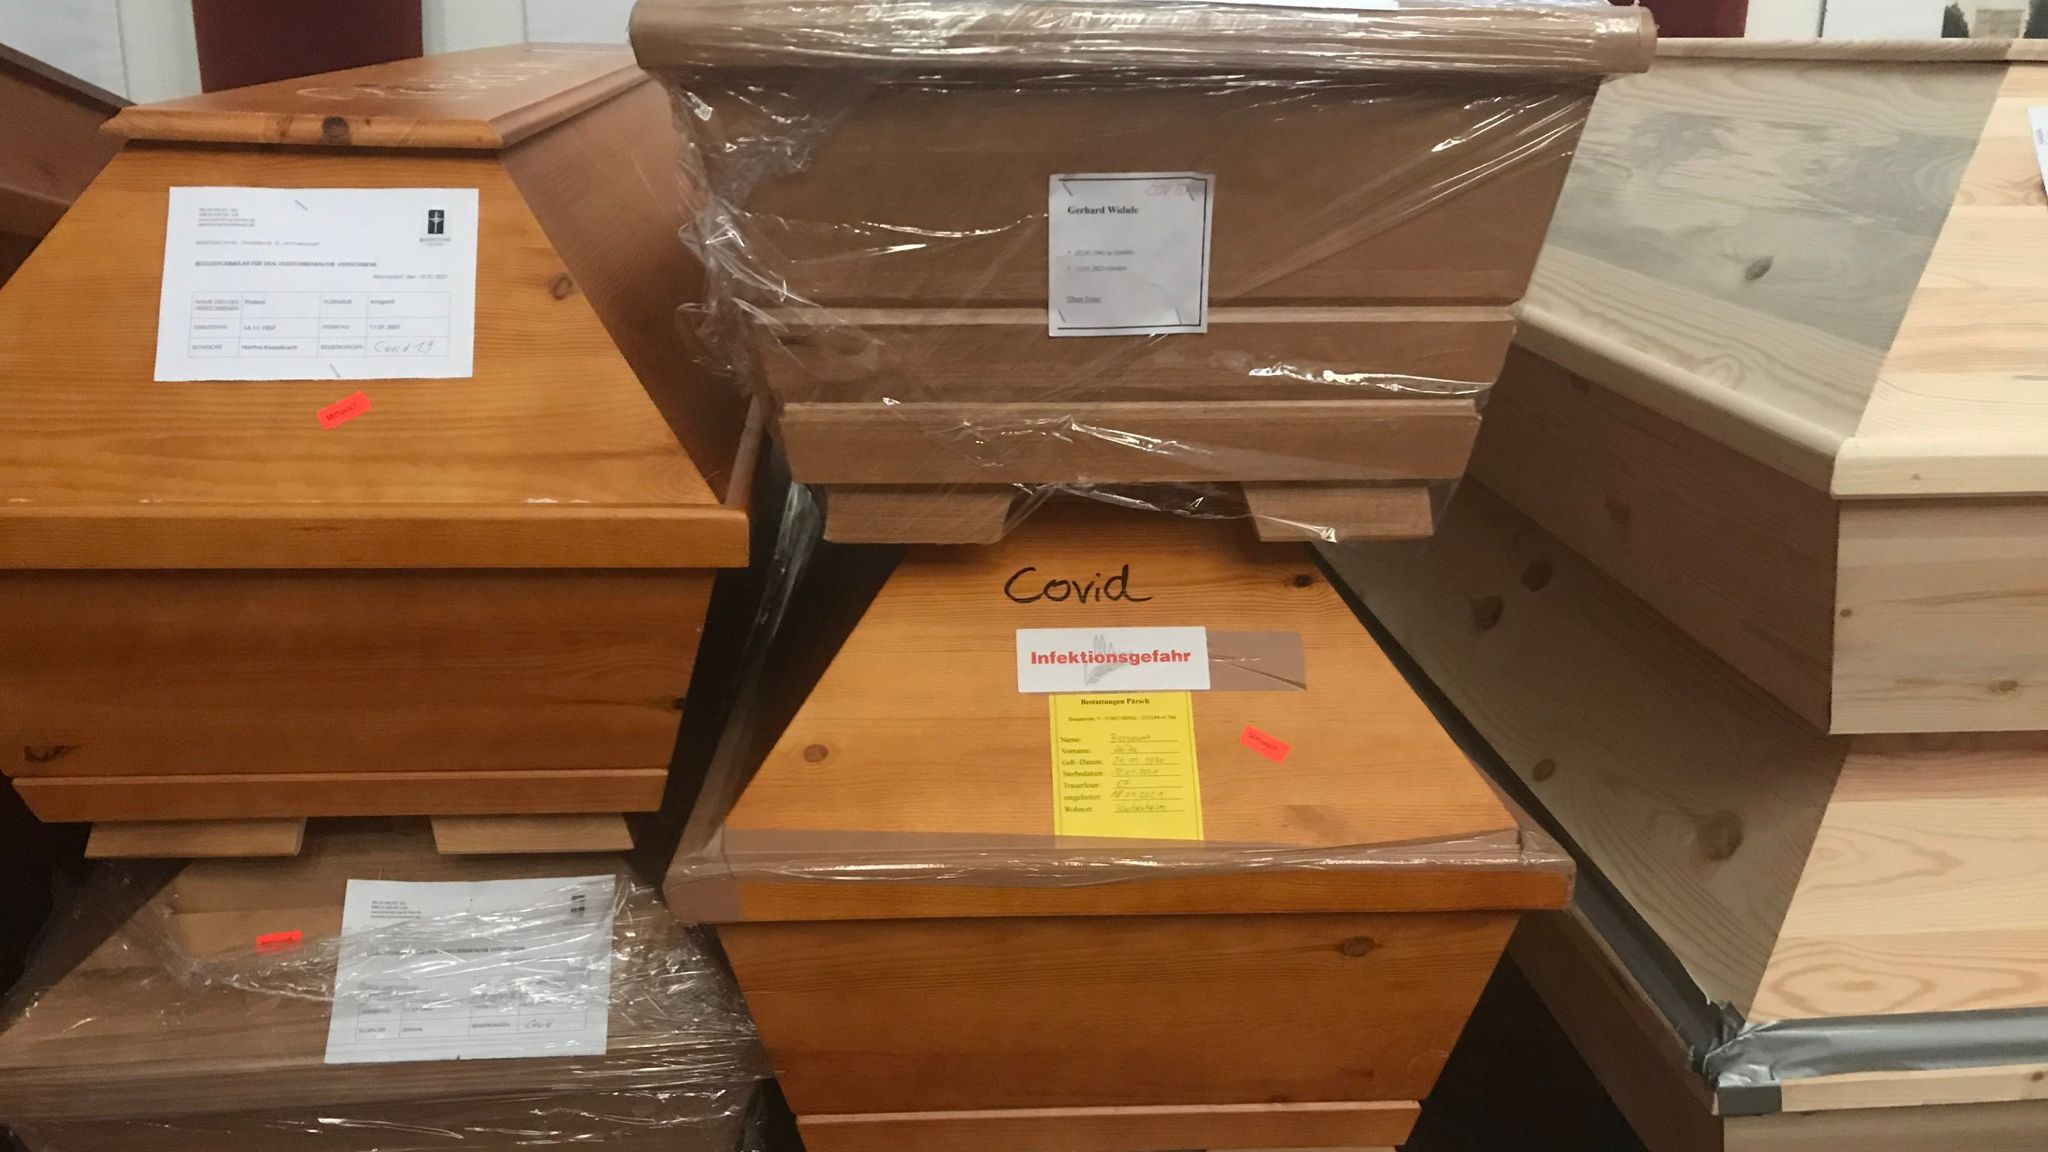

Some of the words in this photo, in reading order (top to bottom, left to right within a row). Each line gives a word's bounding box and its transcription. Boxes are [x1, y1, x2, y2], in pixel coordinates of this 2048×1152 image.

[1067, 205, 1105, 215] Gerhard
[1004, 564, 1153, 604] Covid
[1031, 650, 1192, 666] Infektionsgefahr
[1081, 698, 1125, 706] Bestattungen
